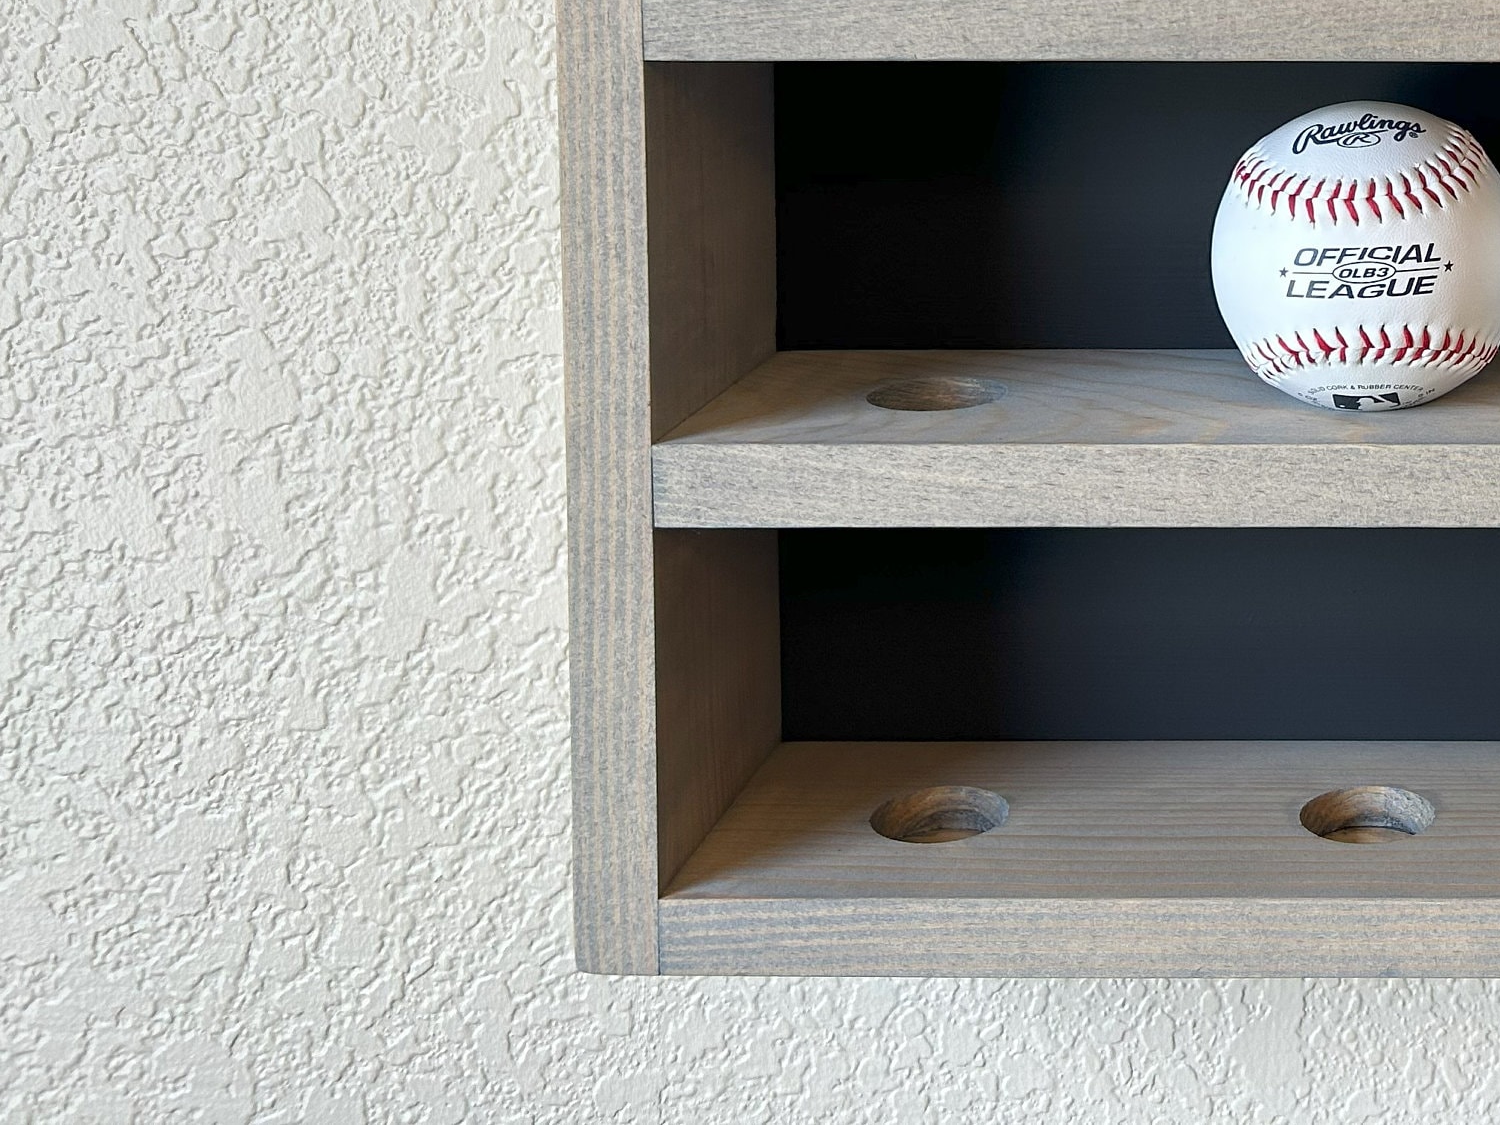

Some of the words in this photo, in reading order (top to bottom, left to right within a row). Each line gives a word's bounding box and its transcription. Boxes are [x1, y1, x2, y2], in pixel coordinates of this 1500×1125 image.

[1292, 113, 1426, 154] Rawlings
[1293, 243, 1441, 267] OFFICIAL
[1338, 267, 1389, 279] OLB3
[1286, 275, 1438, 299] LEAGUE
